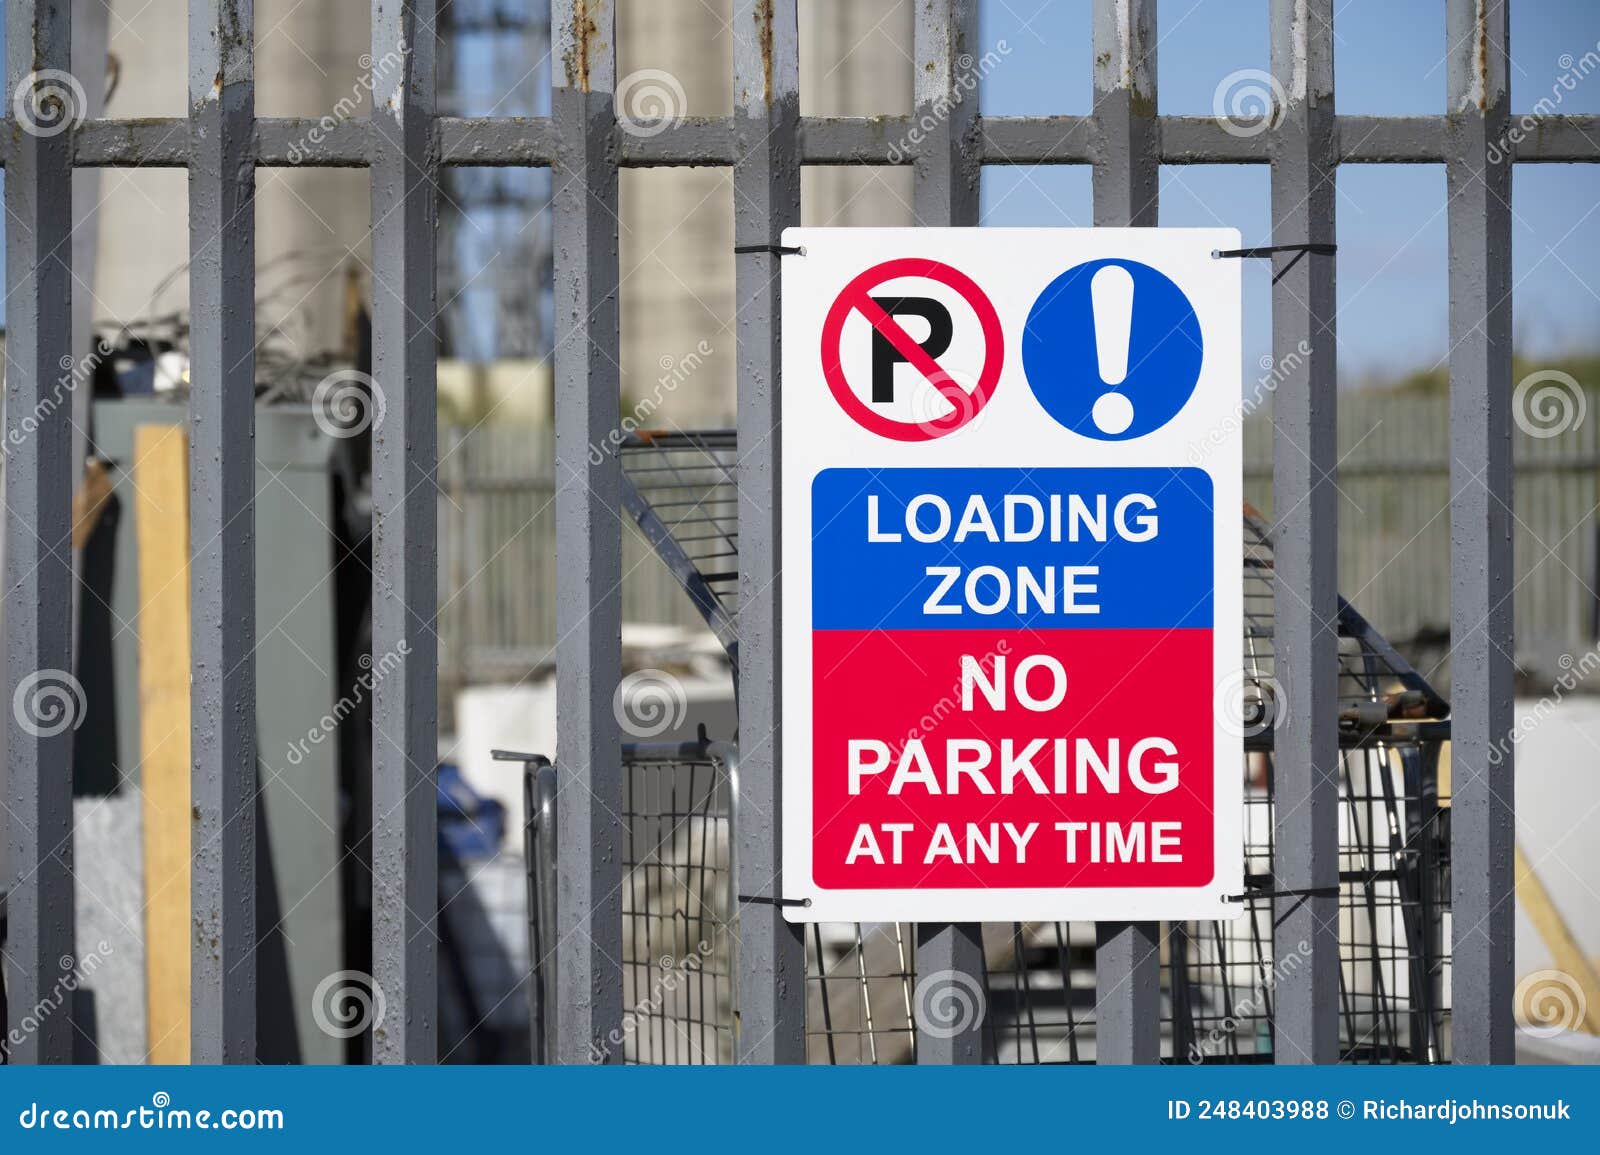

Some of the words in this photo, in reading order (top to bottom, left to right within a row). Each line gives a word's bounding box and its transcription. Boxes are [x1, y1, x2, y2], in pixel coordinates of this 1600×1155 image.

[866, 493, 1160, 543] LOADING
[922, 565, 1101, 615] ZONE
[960, 654, 1068, 712] NO
[847, 737, 1180, 795] PARKING
[845, 823, 914, 865] AT
[923, 822, 1039, 864] ANY
[1055, 821, 1183, 863] TIME
